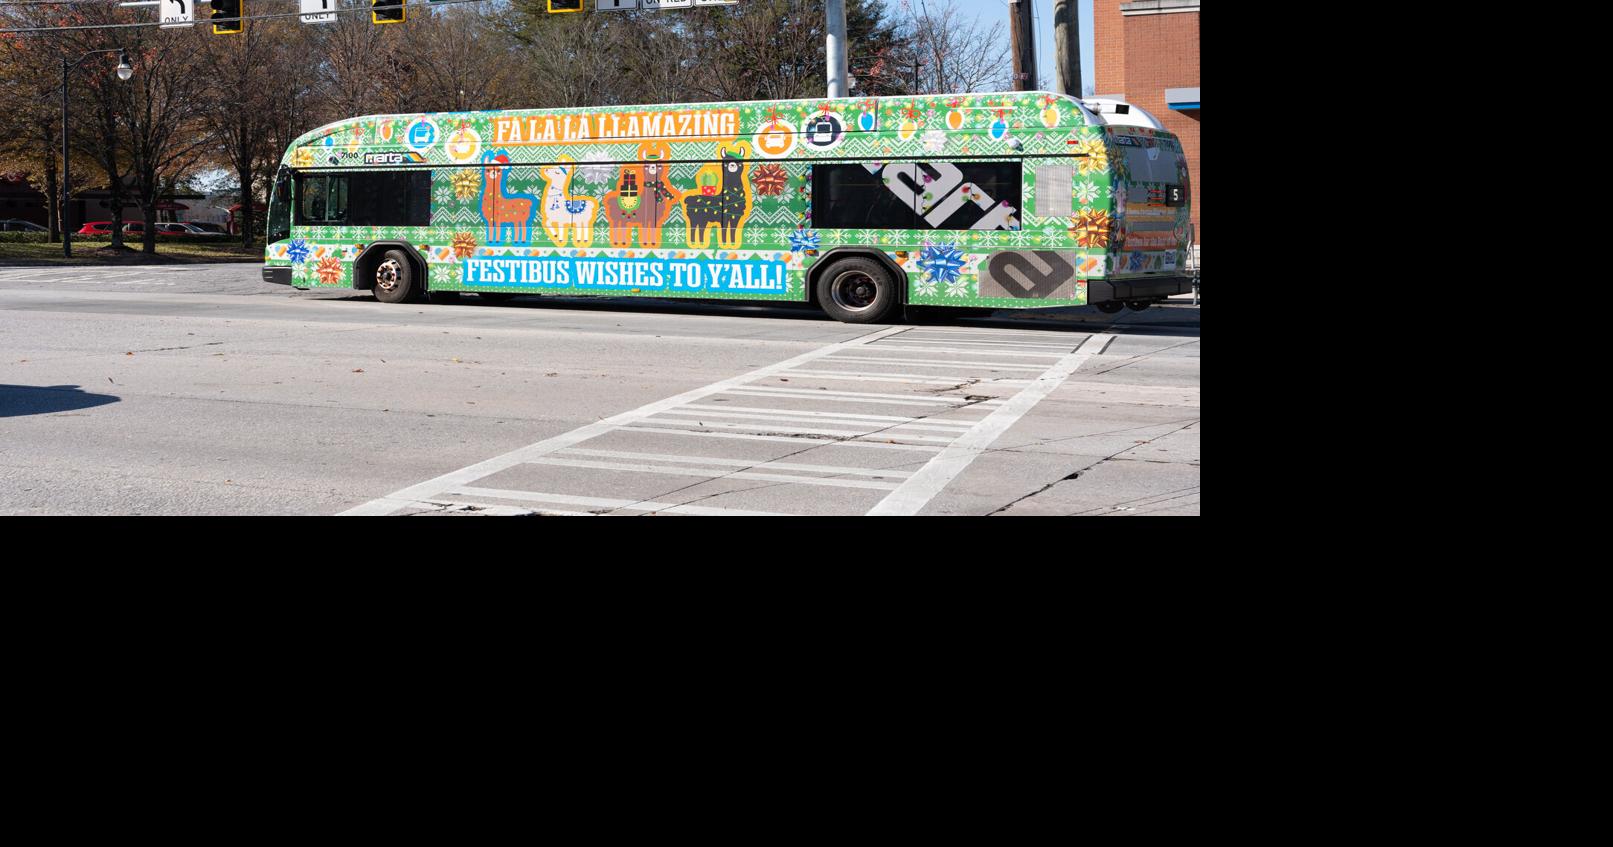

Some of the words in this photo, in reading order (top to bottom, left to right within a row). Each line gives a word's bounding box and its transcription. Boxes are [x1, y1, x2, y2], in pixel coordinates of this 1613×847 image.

[164, 16, 188, 24] ONLY
[497, 119, 522, 143] FA
[528, 117, 555, 141] LA
[564, 115, 590, 140] LA
[598, 112, 736, 139] LLAMAZING
[365, 152, 403, 163] marta
[1173, 188, 1179, 201] 5
[466, 258, 570, 284] FESTIBUS
[574, 260, 664, 287] WISHES
[669, 261, 700, 288] TO
[707, 262, 783, 290] Y'ALL!
